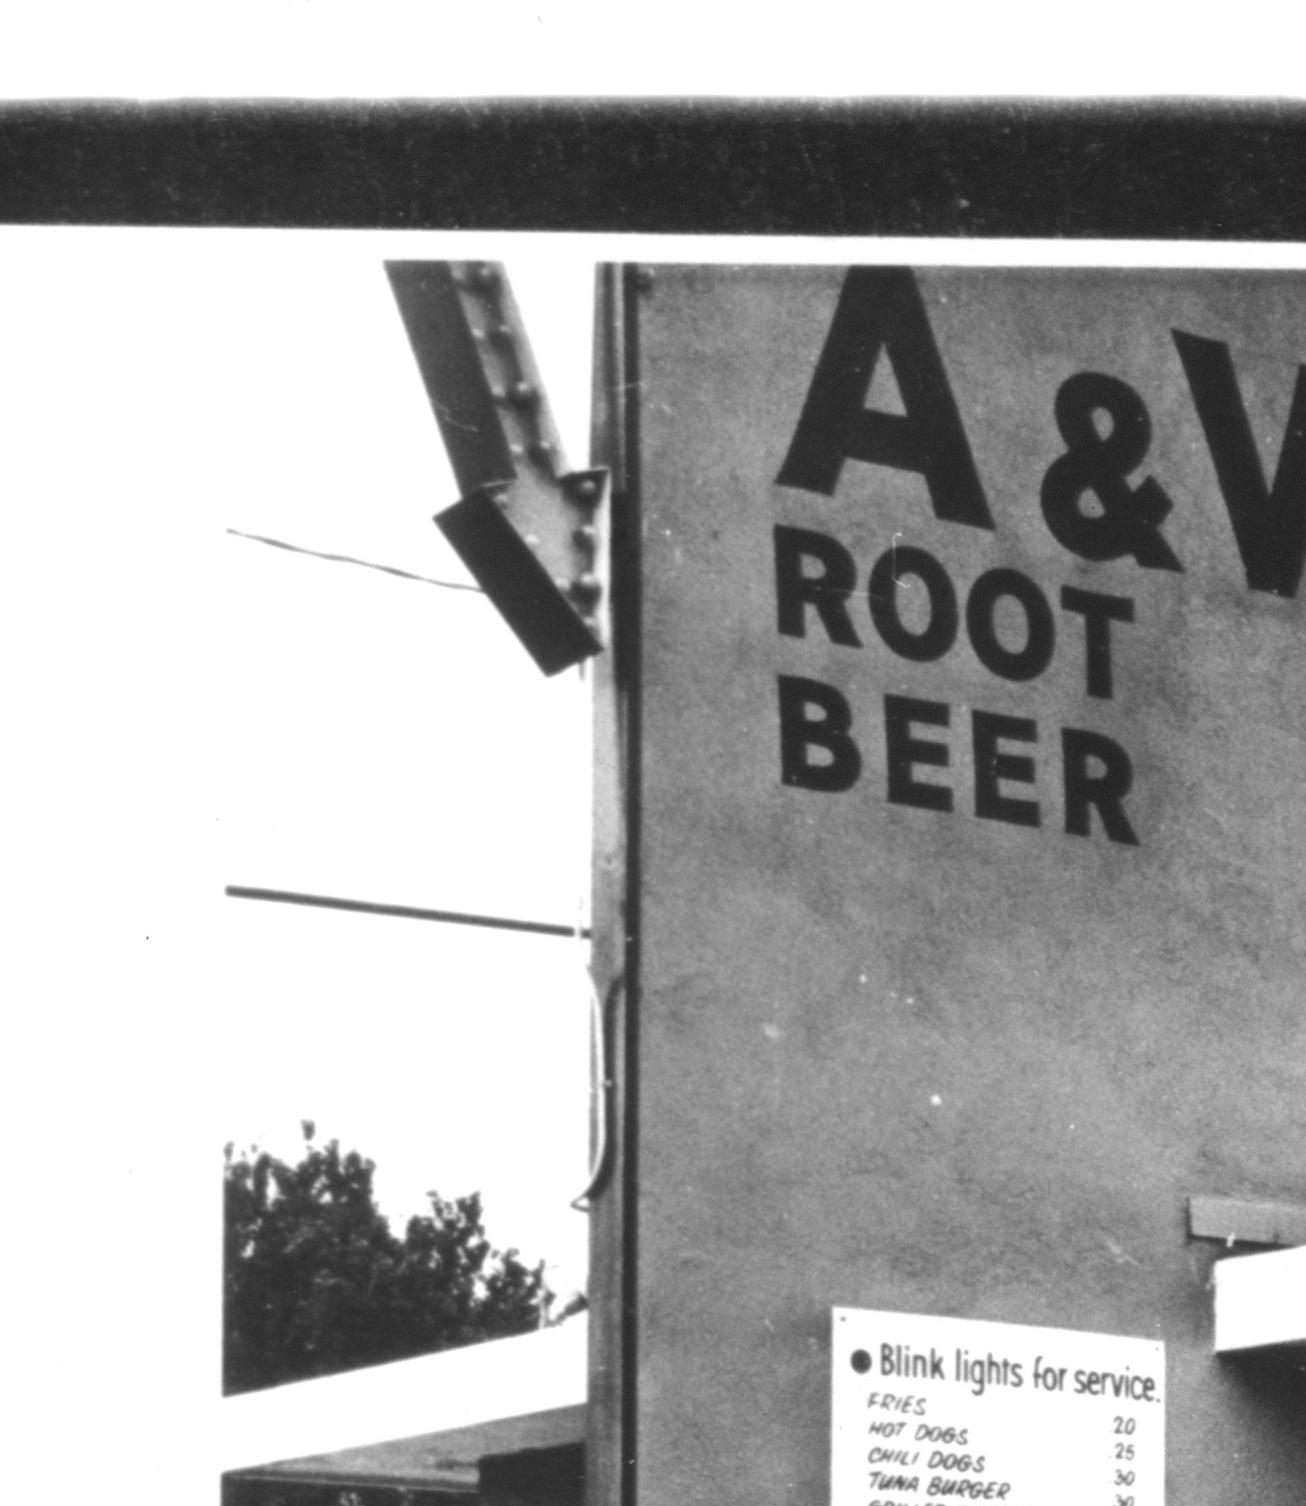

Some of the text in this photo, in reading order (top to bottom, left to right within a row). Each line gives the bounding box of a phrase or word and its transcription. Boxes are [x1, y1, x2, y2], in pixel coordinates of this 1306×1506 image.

[772, 523, 1136, 701] ROOT
[776, 673, 1141, 847] BEER
[879, 1342, 946, 1381] Blink
[955, 1347, 1024, 1397] lights
[1032, 1355, 1068, 1392] for
[867, 1392, 927, 1417] FRIES
[868, 1421, 908, 1439] HOT
[914, 1423, 969, 1446] DOGS
[867, 1446, 920, 1467] CHILI
[926, 1449, 986, 1474] DOGS
[868, 1470, 920, 1493] TUNA
[925, 1475, 1012, 1501] BURGER
